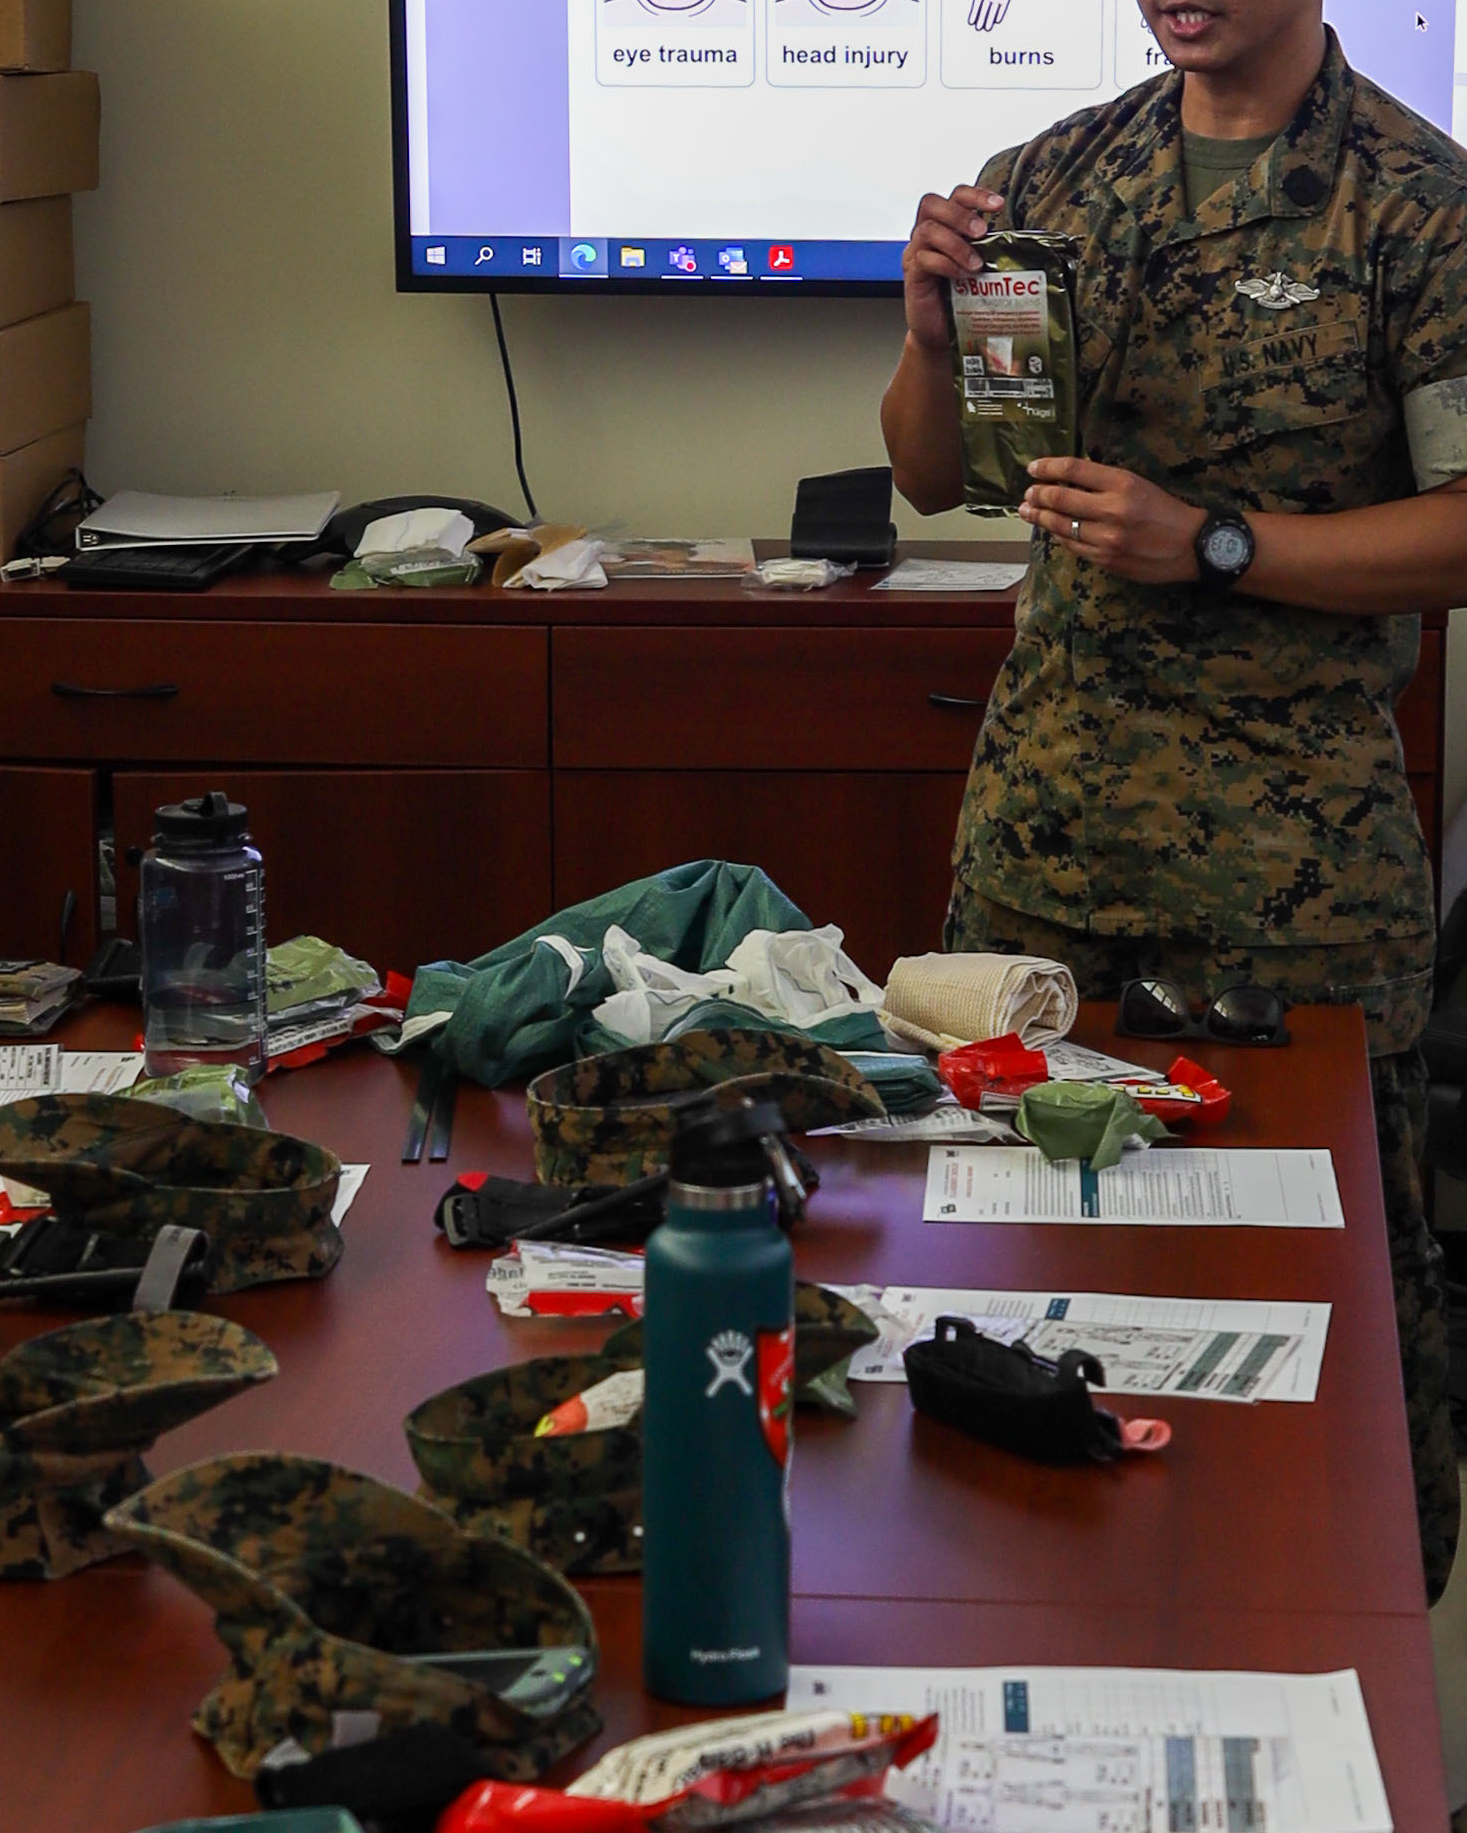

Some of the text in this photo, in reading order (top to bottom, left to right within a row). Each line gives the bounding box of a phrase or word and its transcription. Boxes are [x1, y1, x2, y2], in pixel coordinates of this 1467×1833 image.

[614, 46, 737, 67] eye trauma
[783, 46, 908, 68] head injury
[990, 47, 1054, 65] burns
[970, 278, 1040, 296] BurnTec
[1222, 333, 1317, 376] U.S. NAVY
